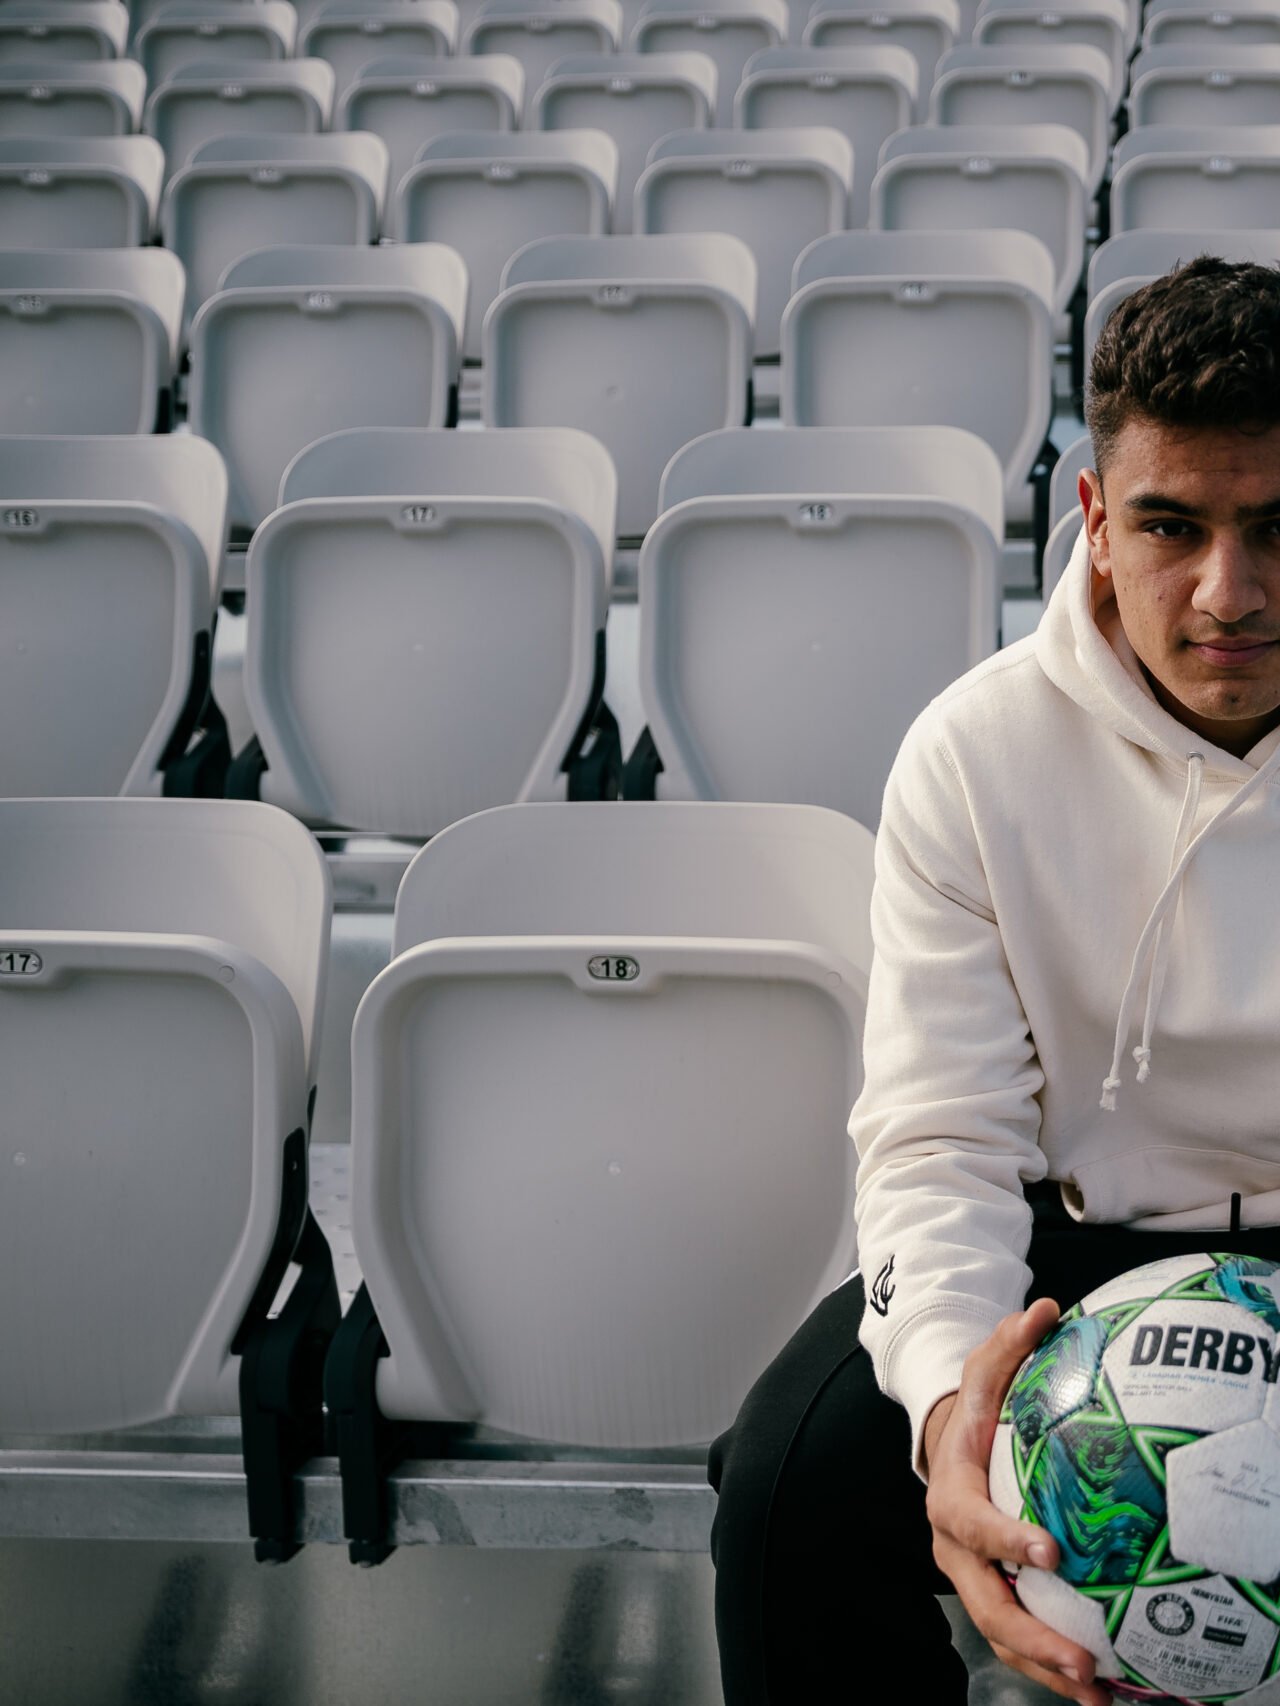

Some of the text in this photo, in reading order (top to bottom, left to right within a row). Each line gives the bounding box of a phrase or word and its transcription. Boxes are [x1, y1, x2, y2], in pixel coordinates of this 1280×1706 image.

[14, 510, 34, 526] 16
[412, 507, 429, 522] 17
[5, 953, 31, 972] 17
[601, 958, 628, 978] 18
[1184, 1374, 1217, 1384] PREMIER
[1191, 1586, 1235, 1606] DERBYSTAR
[1217, 1615, 1242, 1627] FIFA
